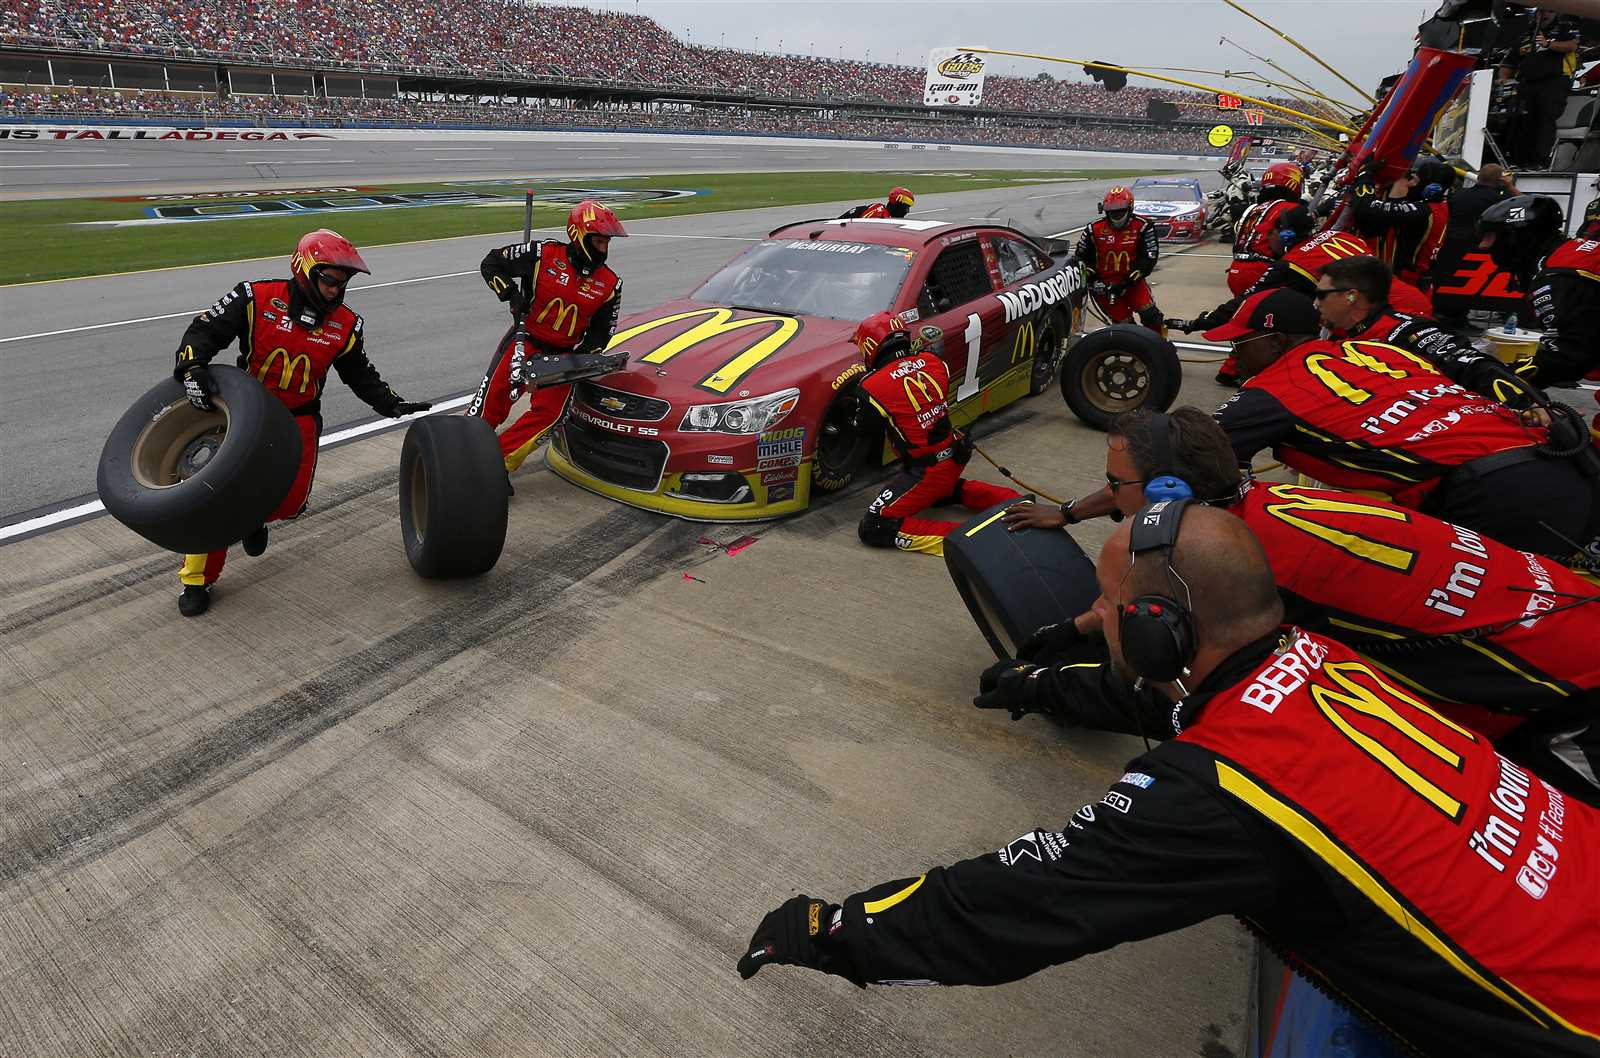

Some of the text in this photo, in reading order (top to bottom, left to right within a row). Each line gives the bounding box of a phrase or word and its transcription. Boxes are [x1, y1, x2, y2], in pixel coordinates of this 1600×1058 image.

[48, 129, 289, 141] TALLADEGA
[1264, 312, 1274, 328] 1
[889, 358, 926, 380] KINCAID
[957, 312, 982, 402] 1
[571, 407, 659, 436] CHEVROLET SS
[758, 440, 802, 457] MAHLE
[1424, 561, 1486, 617] i'm
[1468, 814, 1521, 872] i'm
